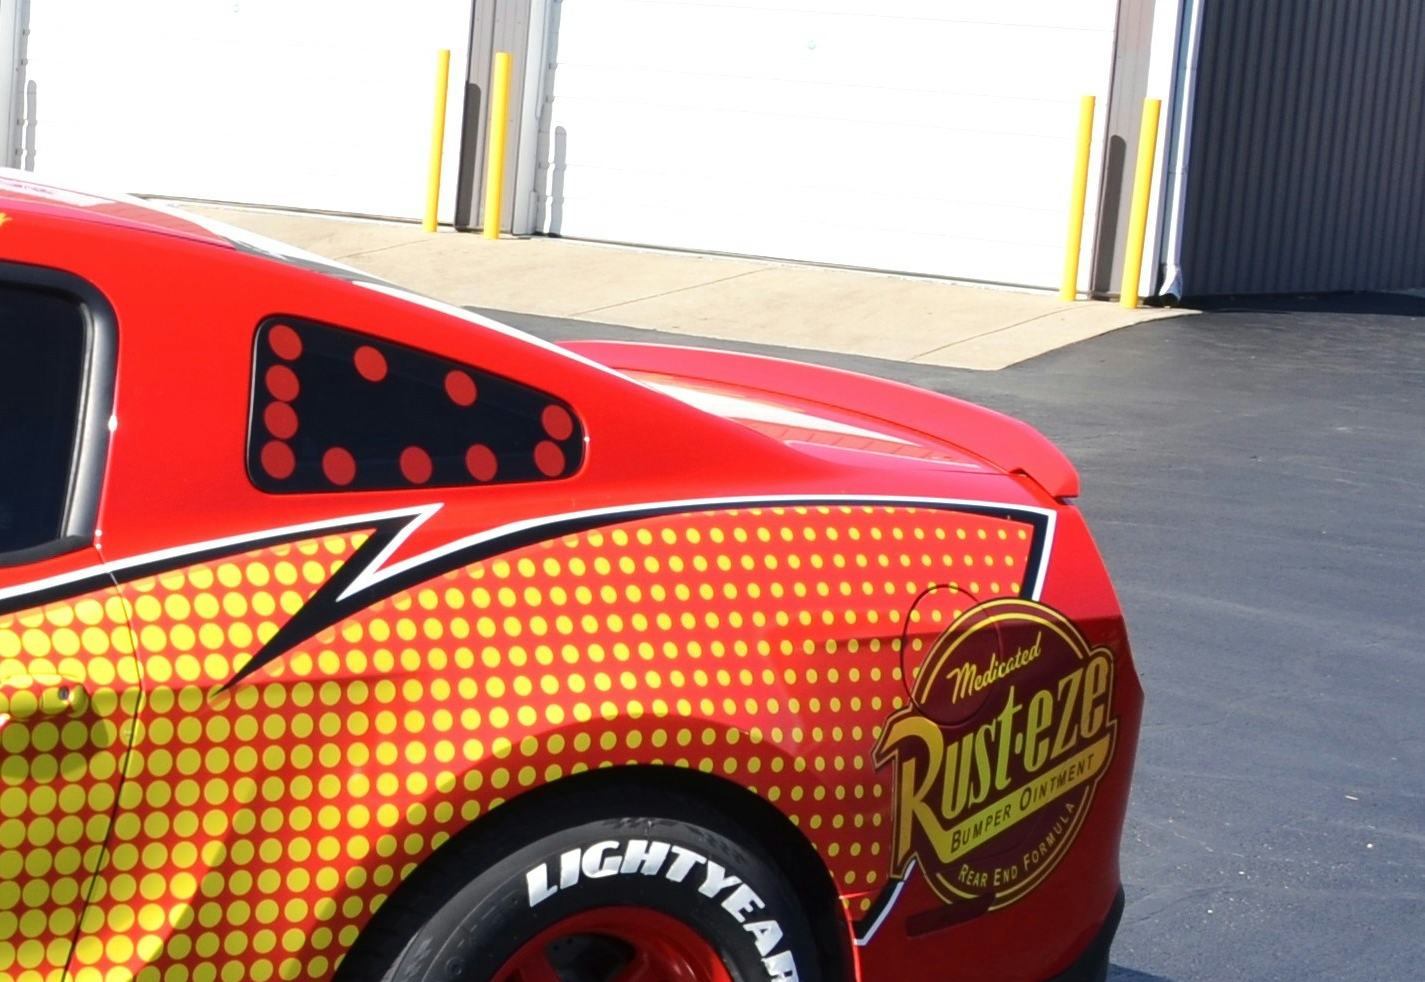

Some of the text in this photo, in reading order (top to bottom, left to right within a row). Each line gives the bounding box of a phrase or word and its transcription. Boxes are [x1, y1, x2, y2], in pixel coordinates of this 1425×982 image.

[946, 630, 1042, 704] Medicated
[957, 801, 1077, 887] REAR END FORMULA
